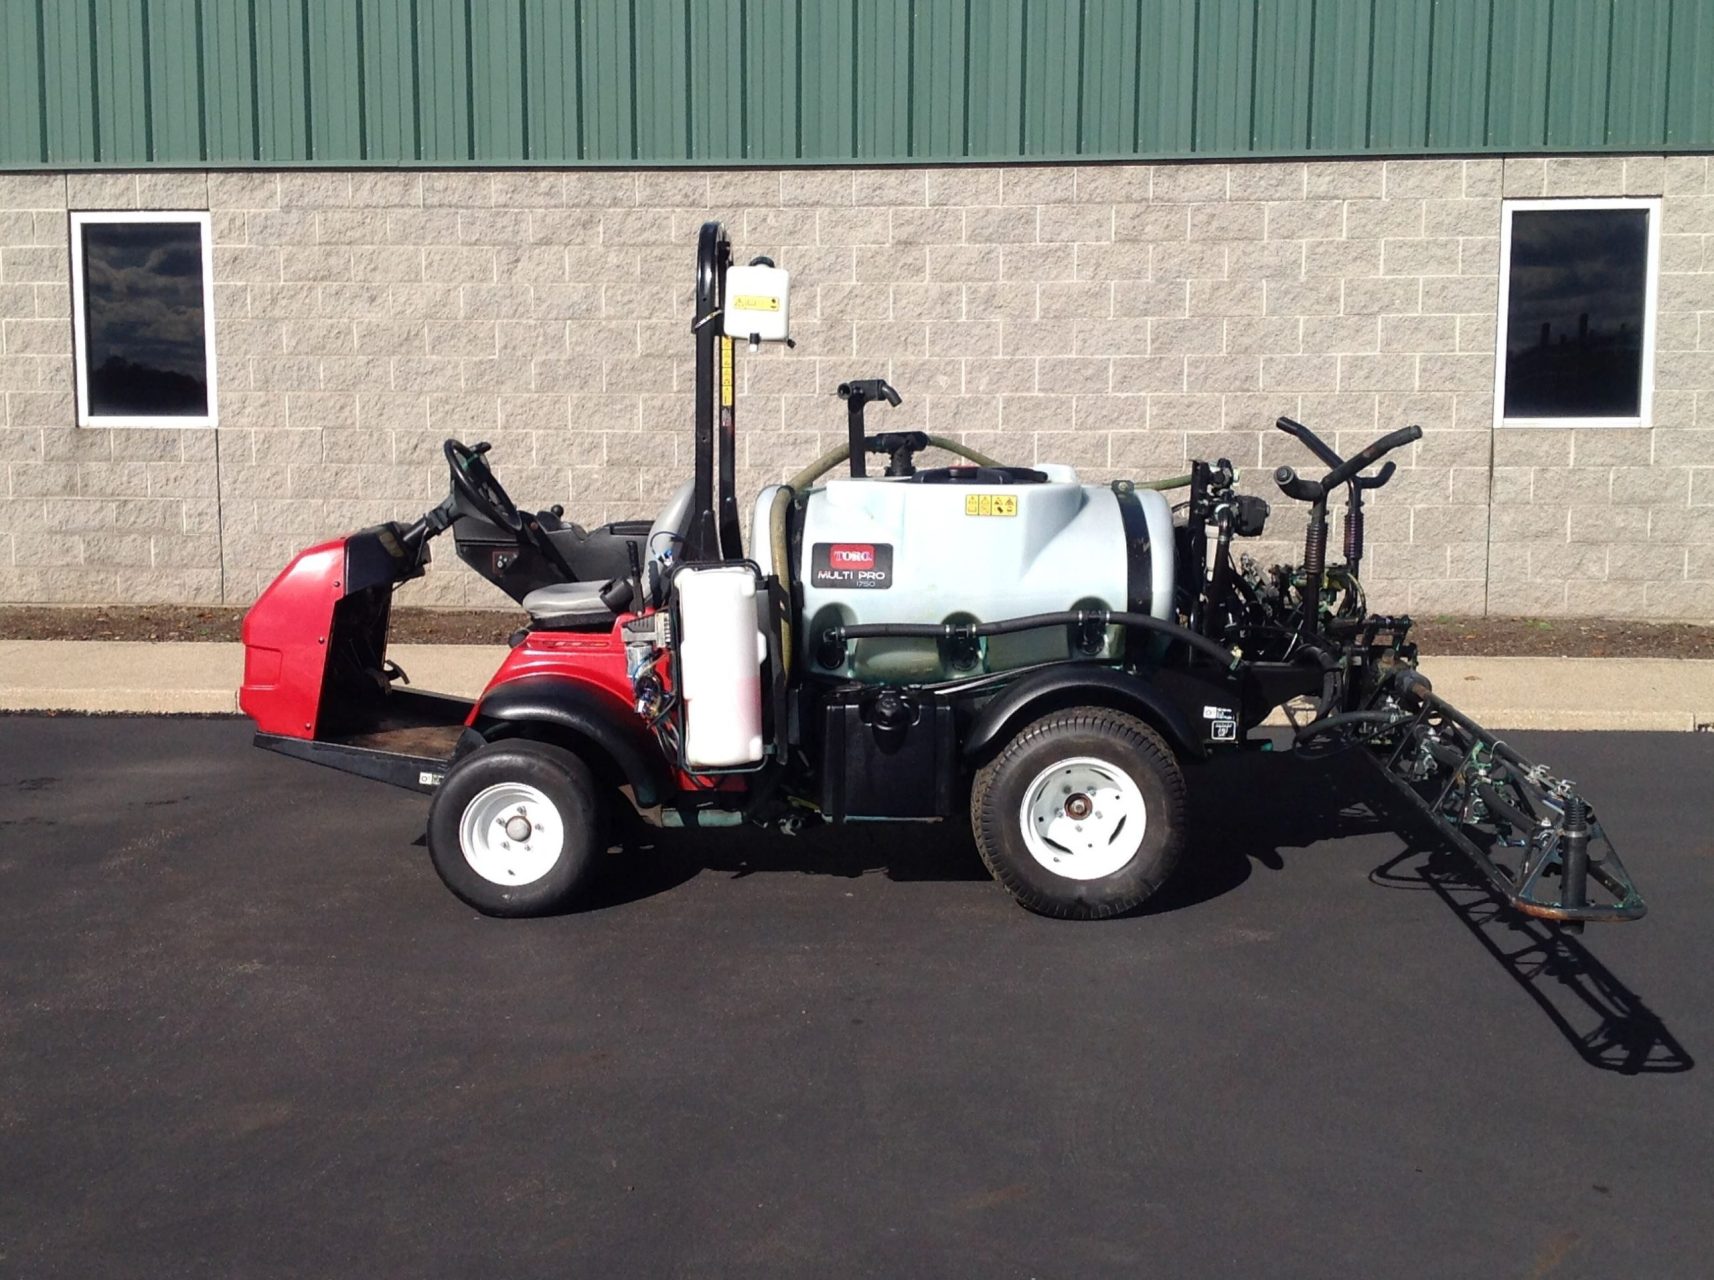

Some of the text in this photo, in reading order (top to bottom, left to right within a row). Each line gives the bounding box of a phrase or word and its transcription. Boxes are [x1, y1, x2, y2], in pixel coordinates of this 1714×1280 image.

[833, 551, 872, 561] TORO
[817, 571, 886, 580] MULTI PRO
